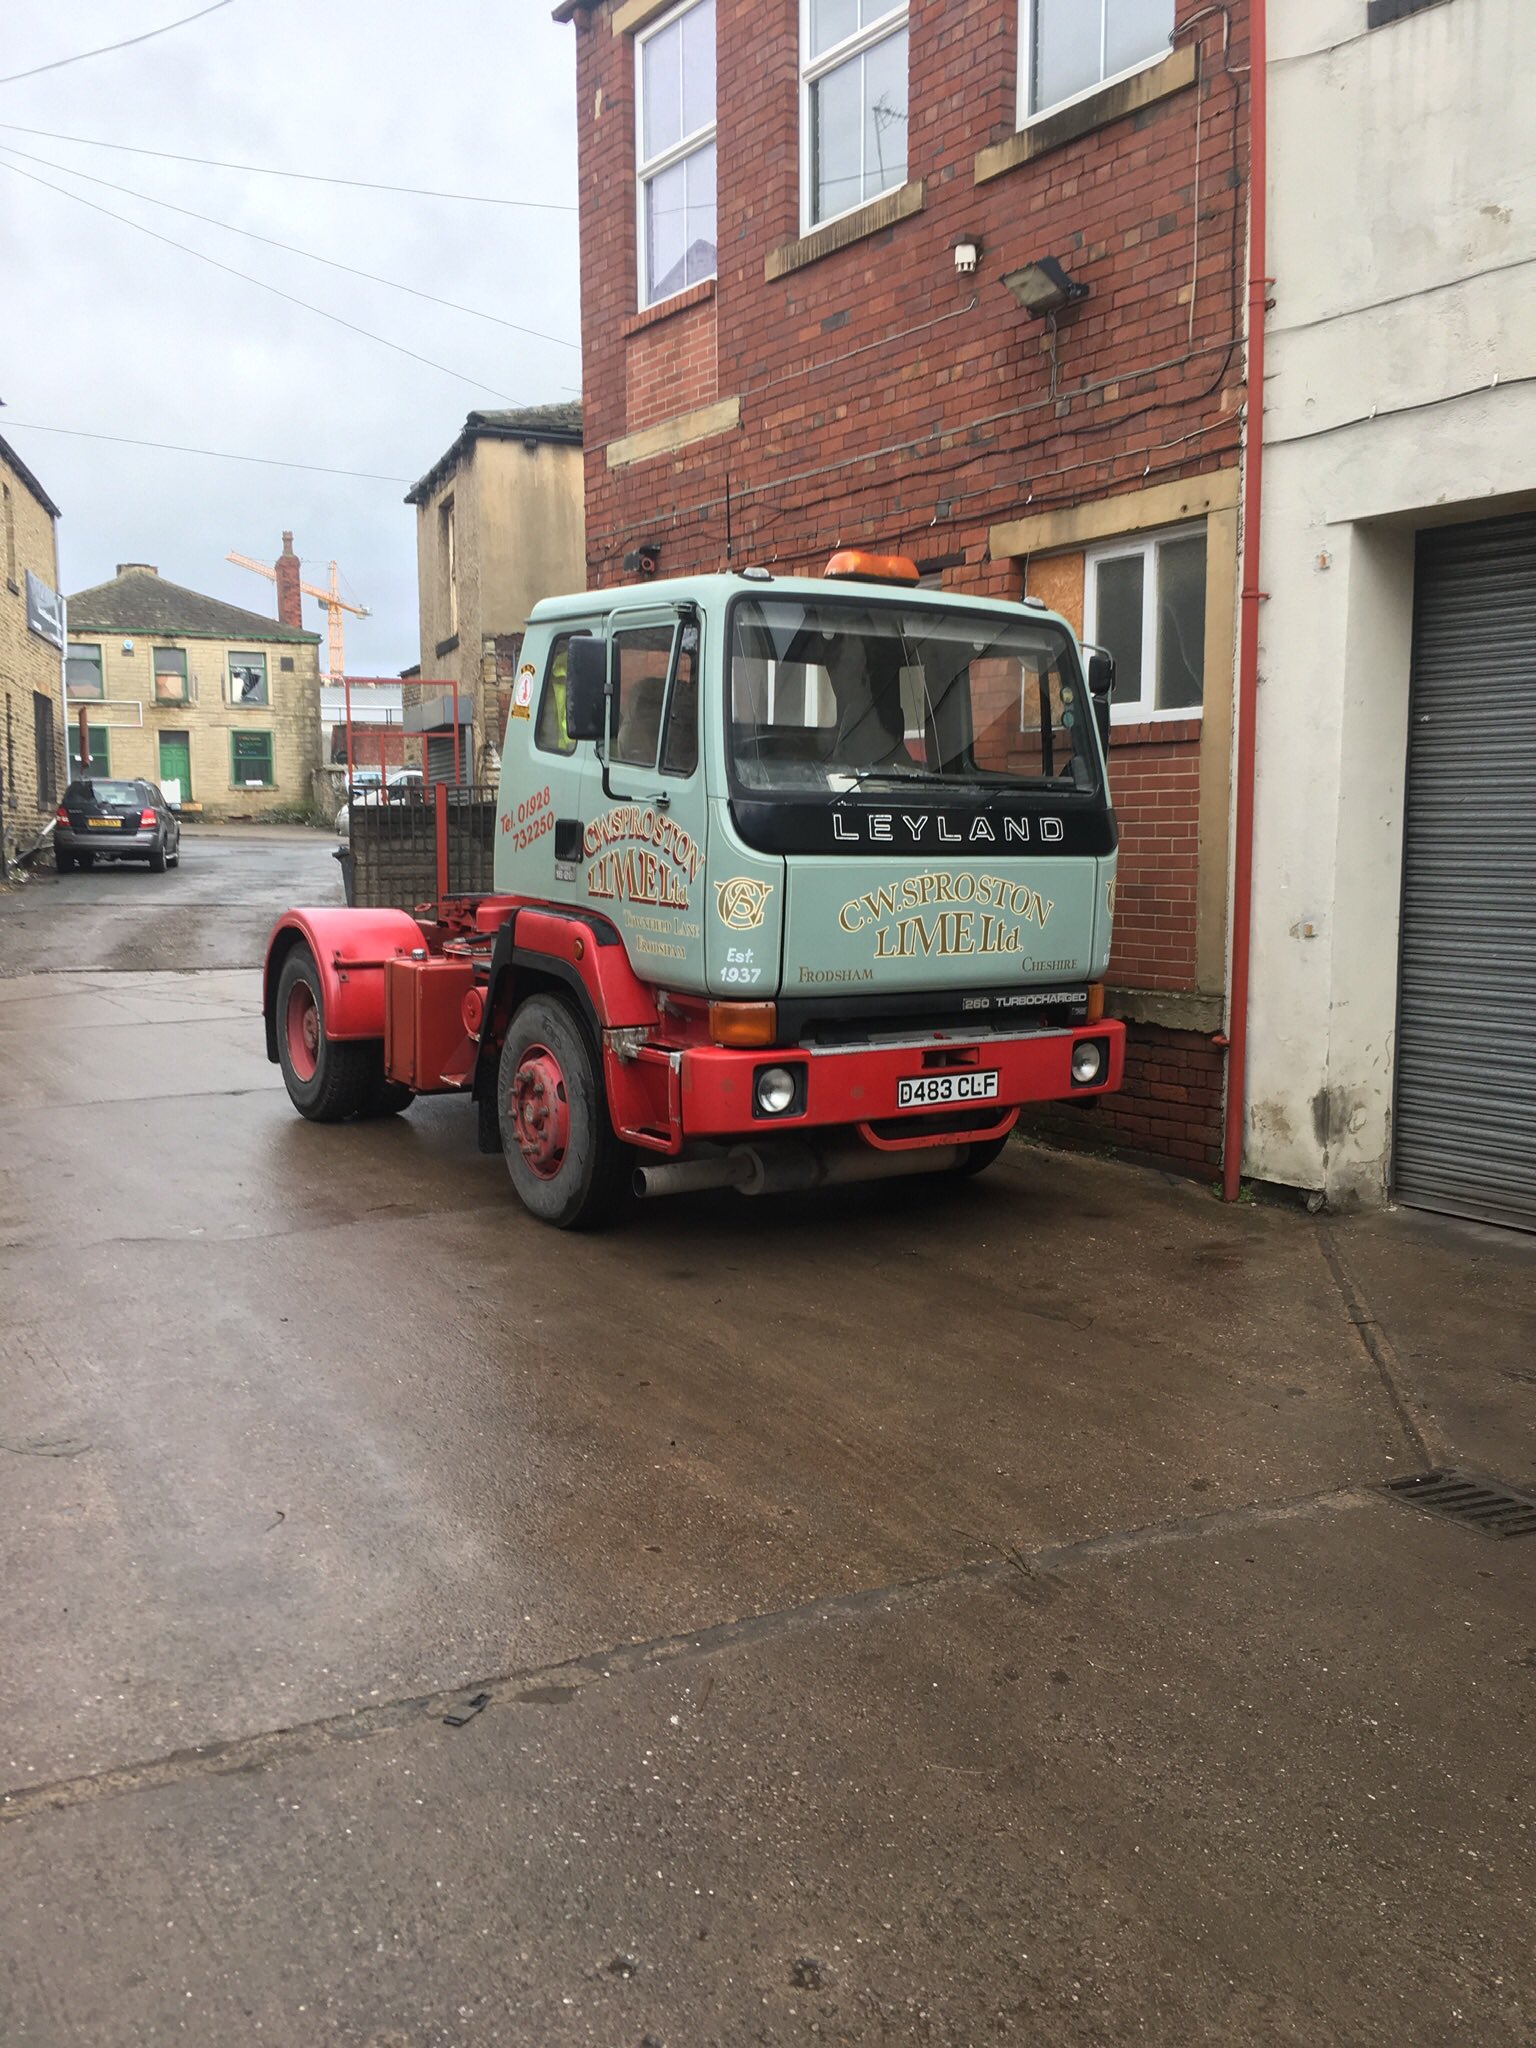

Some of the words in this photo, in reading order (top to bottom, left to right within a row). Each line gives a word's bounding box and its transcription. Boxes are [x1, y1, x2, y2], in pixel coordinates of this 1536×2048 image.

[500, 809, 516, 836] Tel.
[517, 785, 550, 824] 01928
[512, 810, 555, 853] 732250
[832, 814, 1064, 842] LEYLAND
[588, 847, 659, 903] LIME
[873, 910, 976, 960] LIME
[726, 947, 753, 964] Est.
[1021, 956, 1078, 974] CHESHIRE
[720, 966, 762, 983] 1937
[798, 966, 874, 984] FRODSHAM
[964, 997, 990, 1010] 260
[995, 992, 1087, 1008] TURBOCHARGED
[899, 1078, 953, 1105] D483
[957, 1074, 996, 1098] CLF
